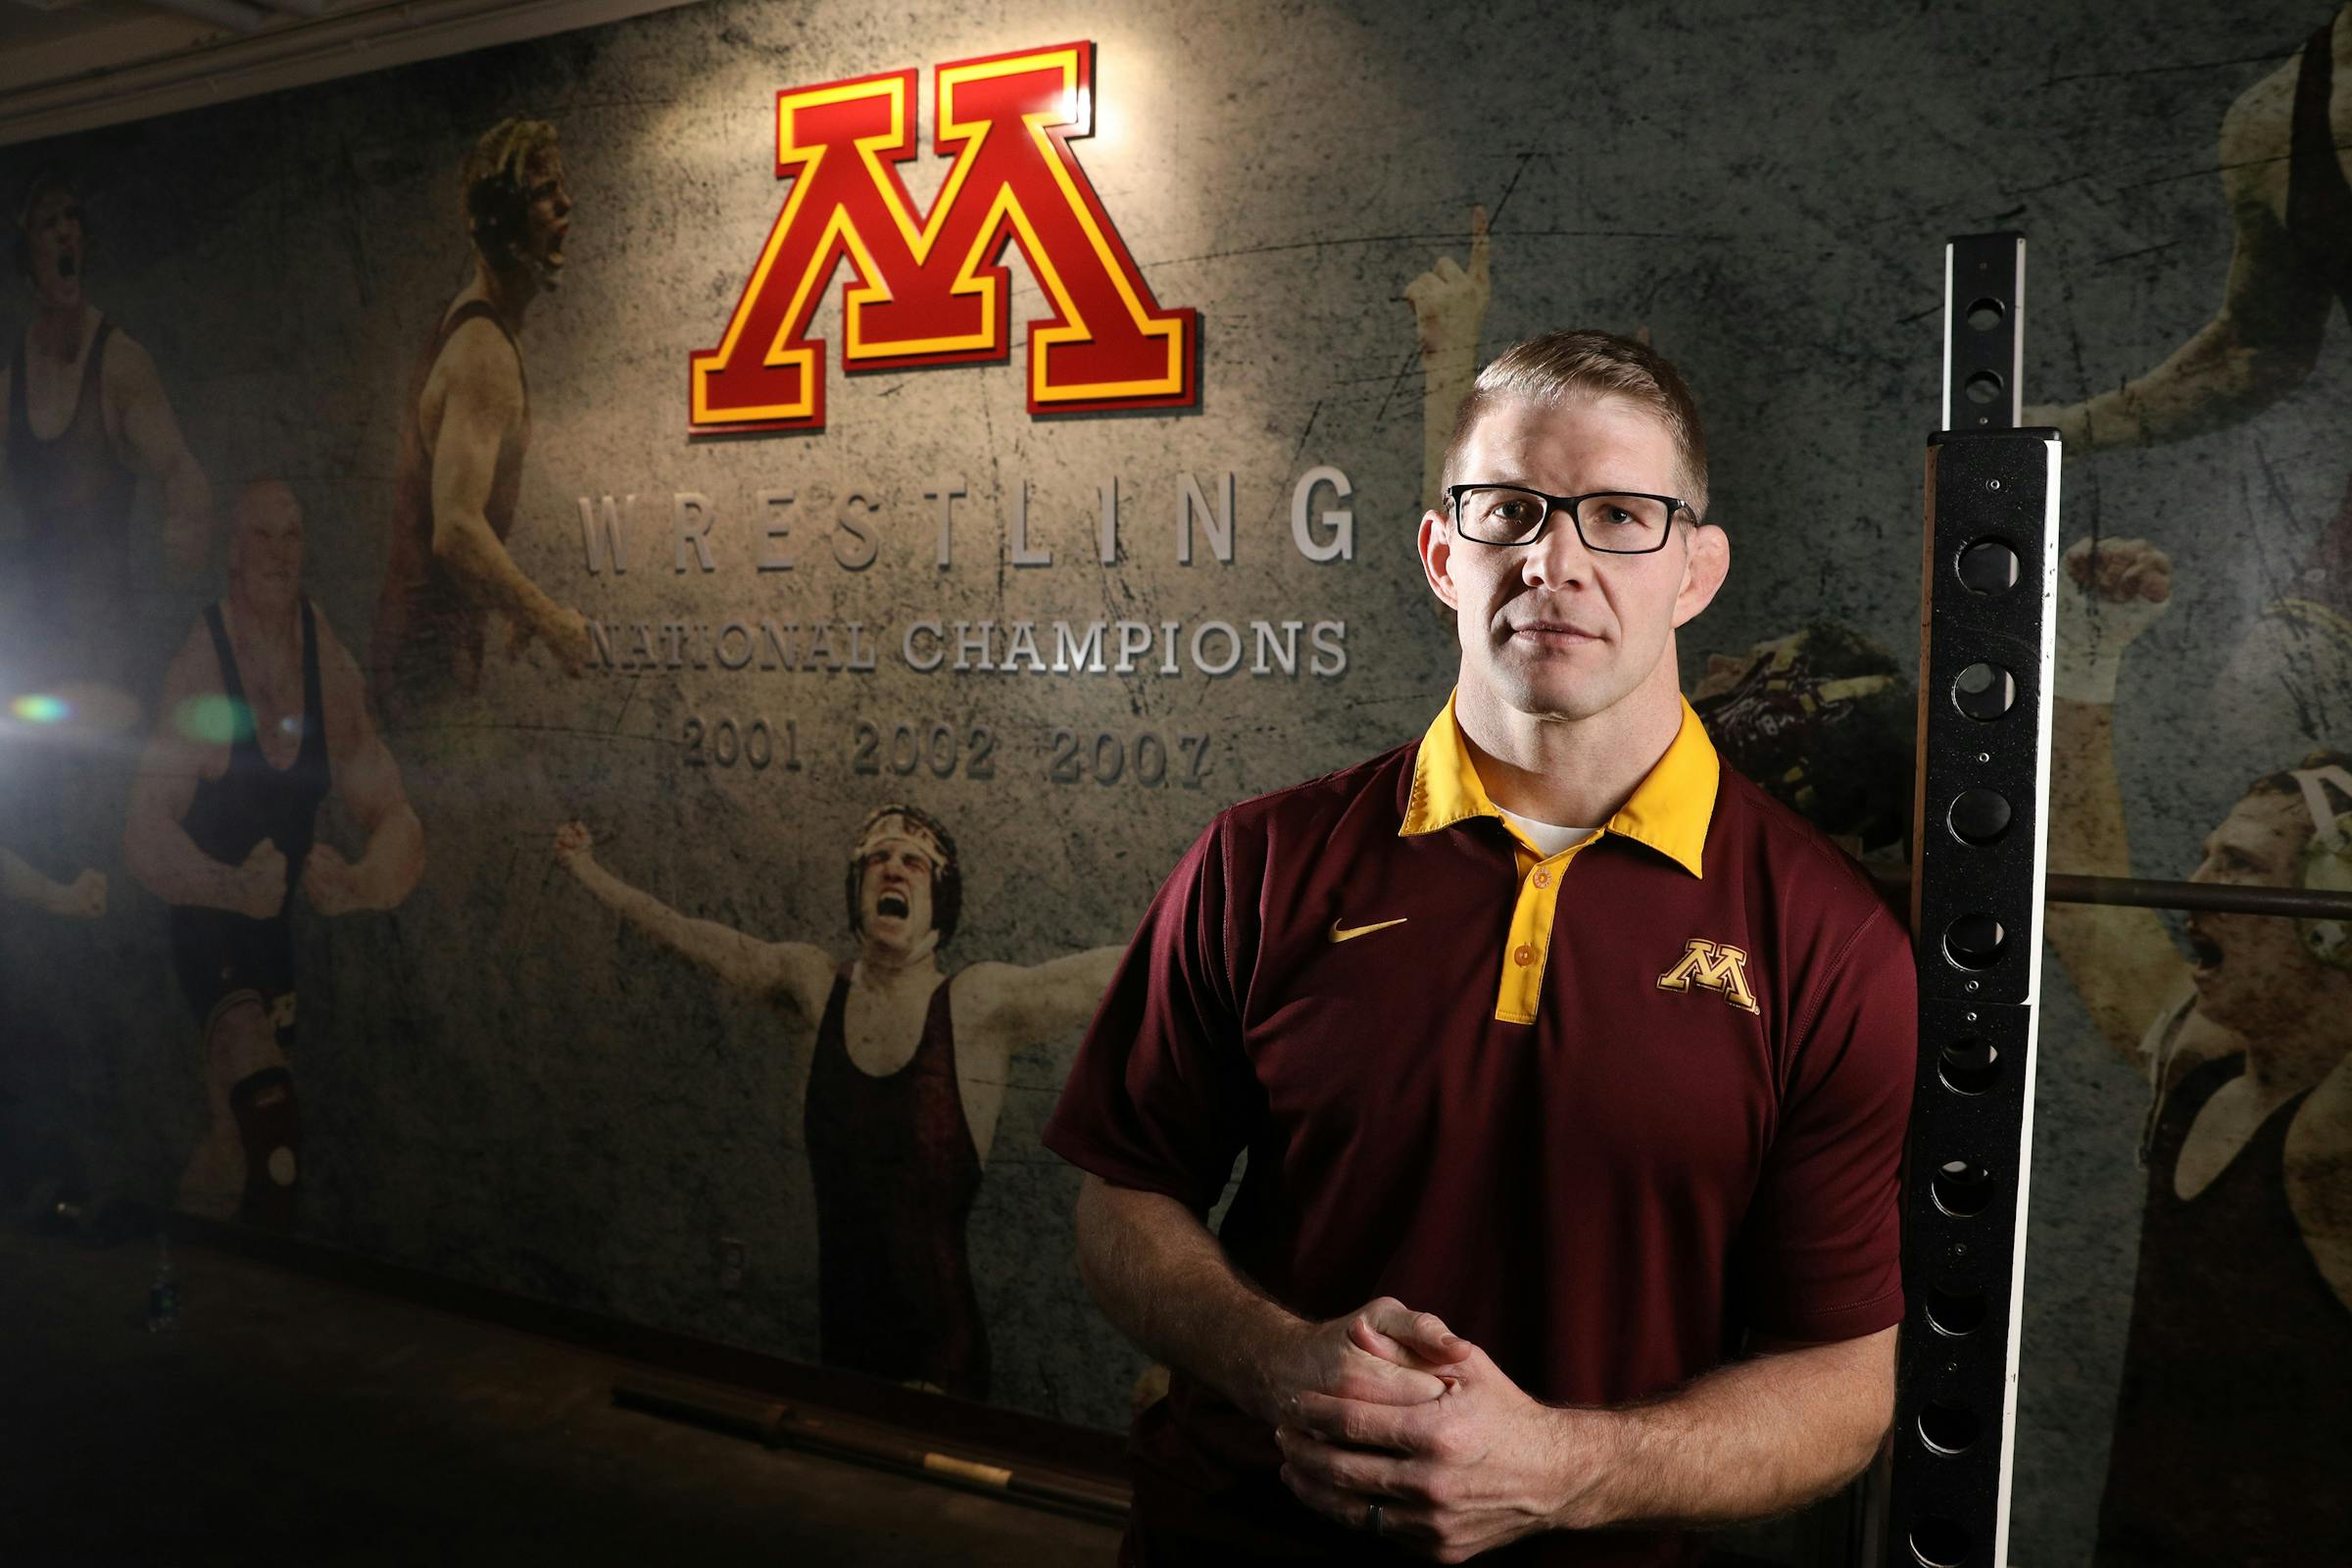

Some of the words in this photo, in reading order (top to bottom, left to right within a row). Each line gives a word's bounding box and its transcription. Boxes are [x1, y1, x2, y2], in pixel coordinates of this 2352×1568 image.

[690, 40, 1196, 435] M
[578, 465, 1356, 572] WRESTLING
[586, 619, 876, 673] NATIONAL
[903, 619, 1349, 677] CHAMPIONS
[684, 716, 802, 771] 2001
[854, 718, 996, 780] 2002
[1050, 728, 1210, 789] 2007
[1657, 939, 1757, 1012] M
